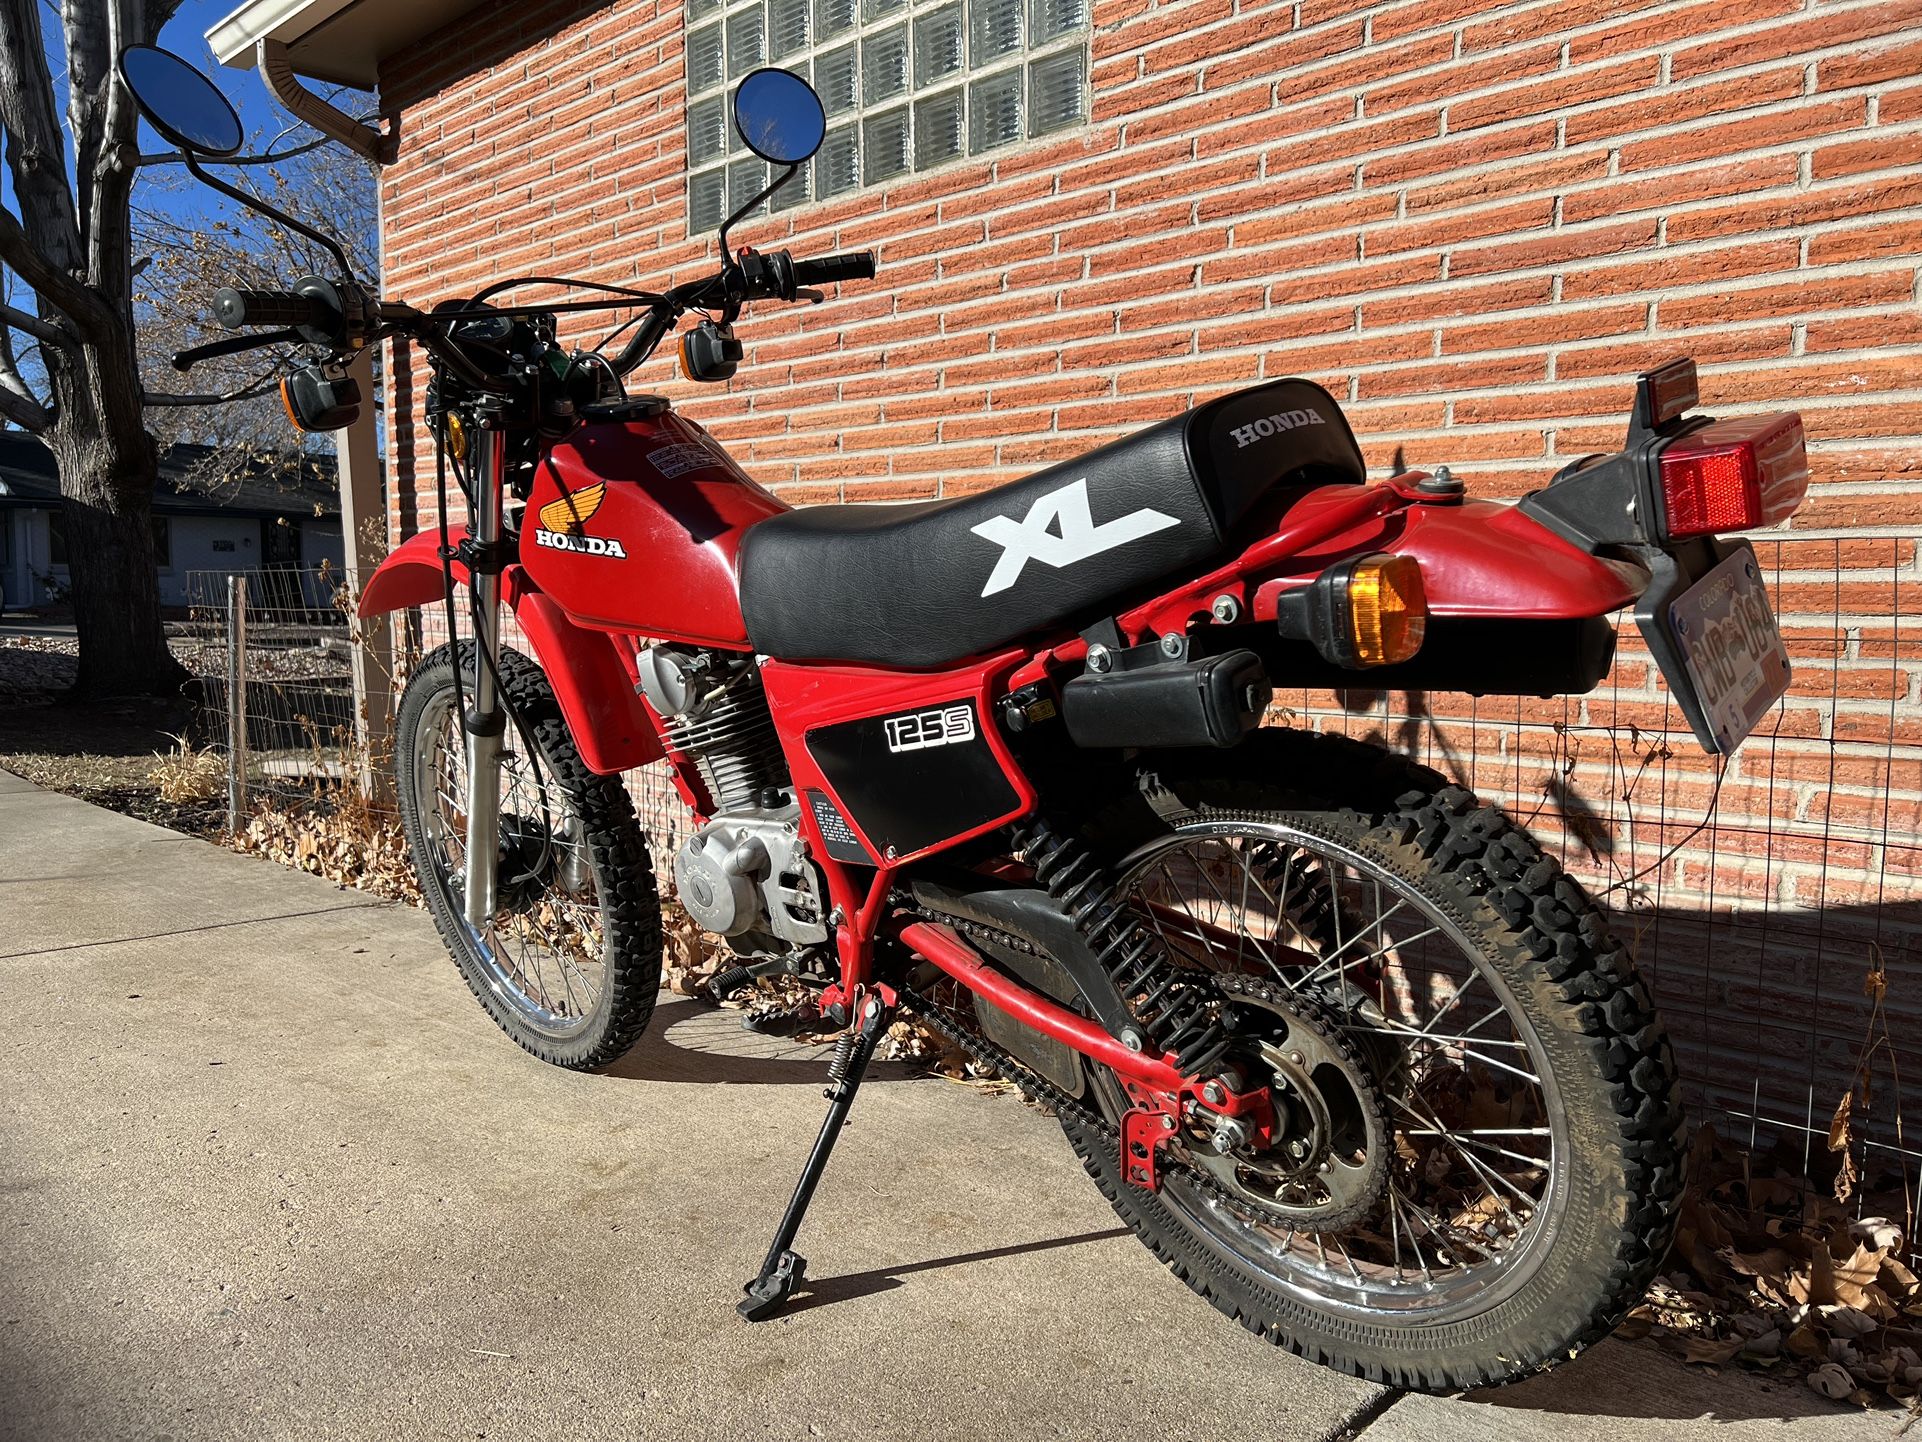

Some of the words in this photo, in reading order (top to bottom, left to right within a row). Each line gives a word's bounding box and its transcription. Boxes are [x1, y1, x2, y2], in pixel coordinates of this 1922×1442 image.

[1230, 408, 1326, 449] HONDA
[535, 529, 627, 559] HONDA
[970, 477, 1182, 598] XL
[1699, 572, 1736, 612] COLORADO
[884, 704, 976, 753] 125S
